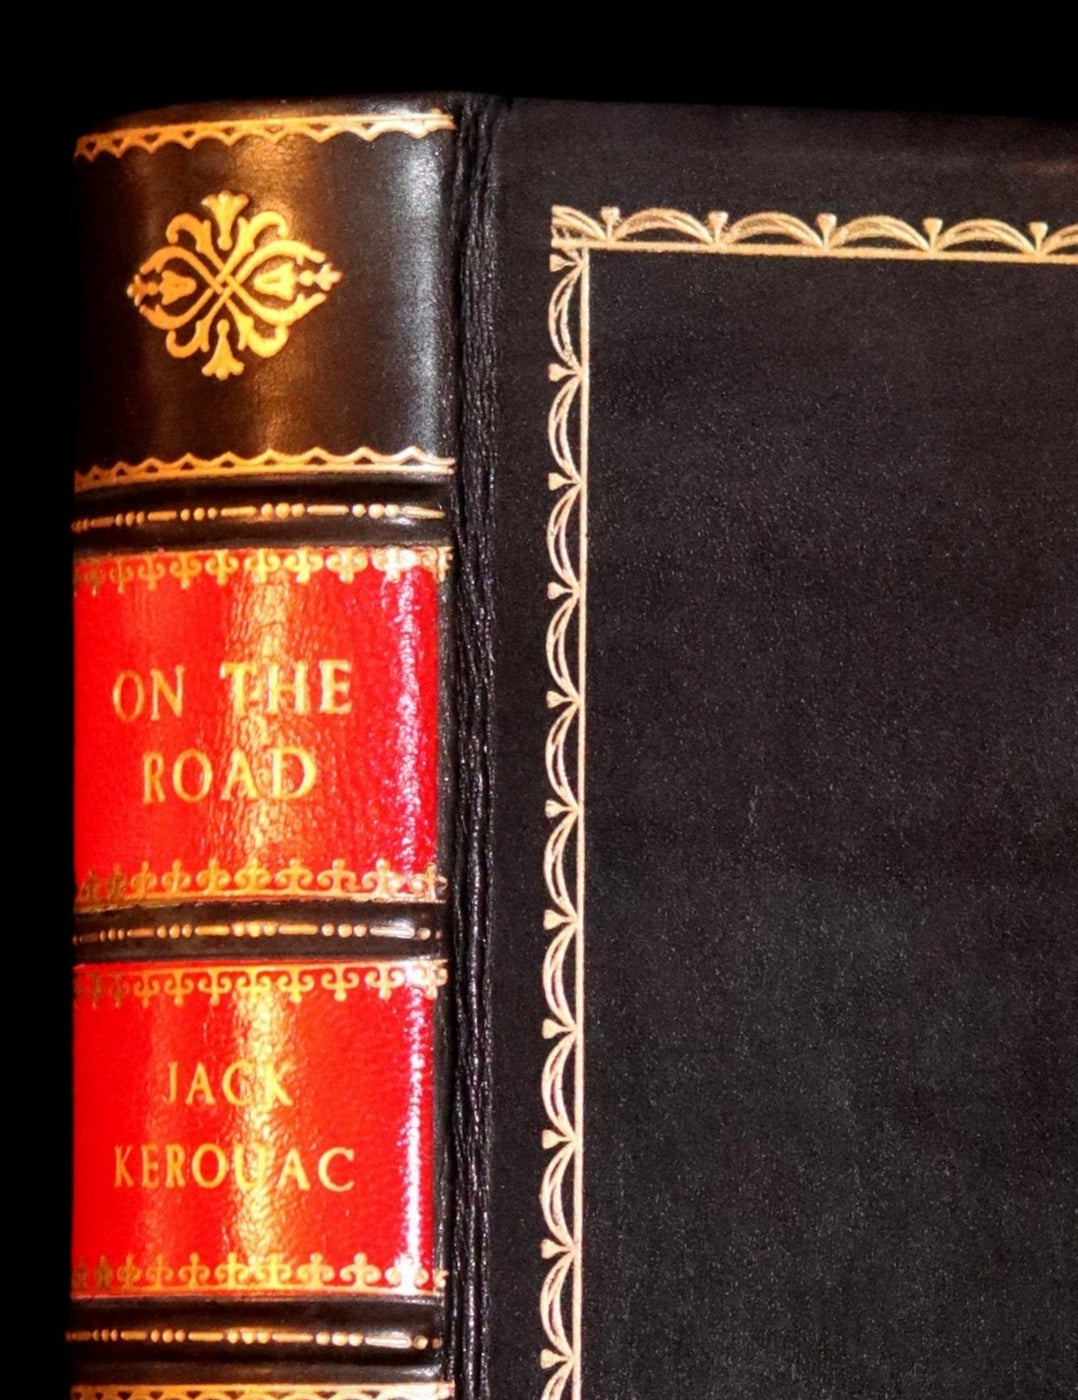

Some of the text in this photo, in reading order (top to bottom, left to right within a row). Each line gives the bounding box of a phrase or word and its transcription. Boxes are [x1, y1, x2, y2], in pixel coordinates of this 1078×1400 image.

[112, 658, 353, 723] ON THE
[142, 745, 318, 805] ROAD
[163, 1059, 294, 1106] JACK
[114, 1142, 356, 1192] KEROUAC
